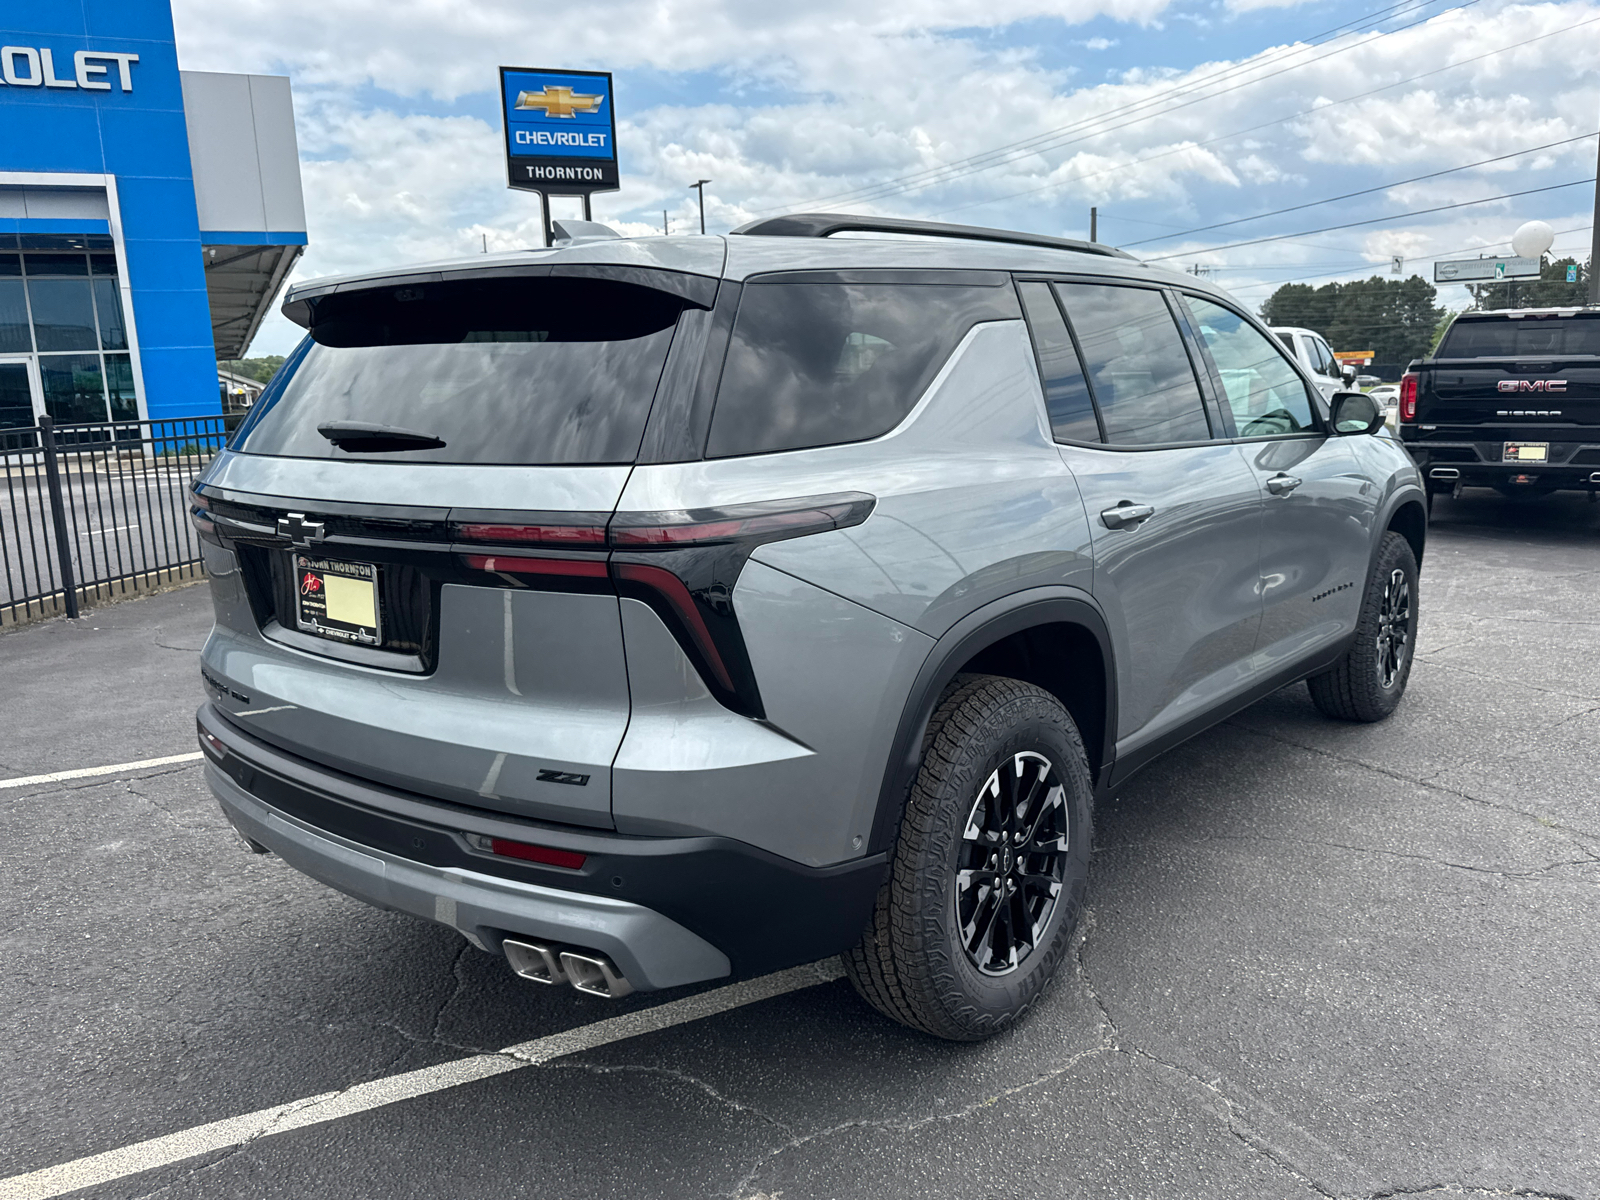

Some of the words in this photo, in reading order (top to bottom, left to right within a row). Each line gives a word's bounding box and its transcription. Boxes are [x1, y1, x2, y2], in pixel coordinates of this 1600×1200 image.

[0, 46, 139, 92] OLET
[515, 130, 607, 147] CHEVROLET
[526, 165, 603, 180] THORNTON
[1497, 379, 1568, 393] GMC
[311, 560, 330, 571] JOHN
[330, 561, 371, 577] THORNTON
[325, 629, 350, 639] CHEVROLET
[536, 768, 591, 787] Z71
